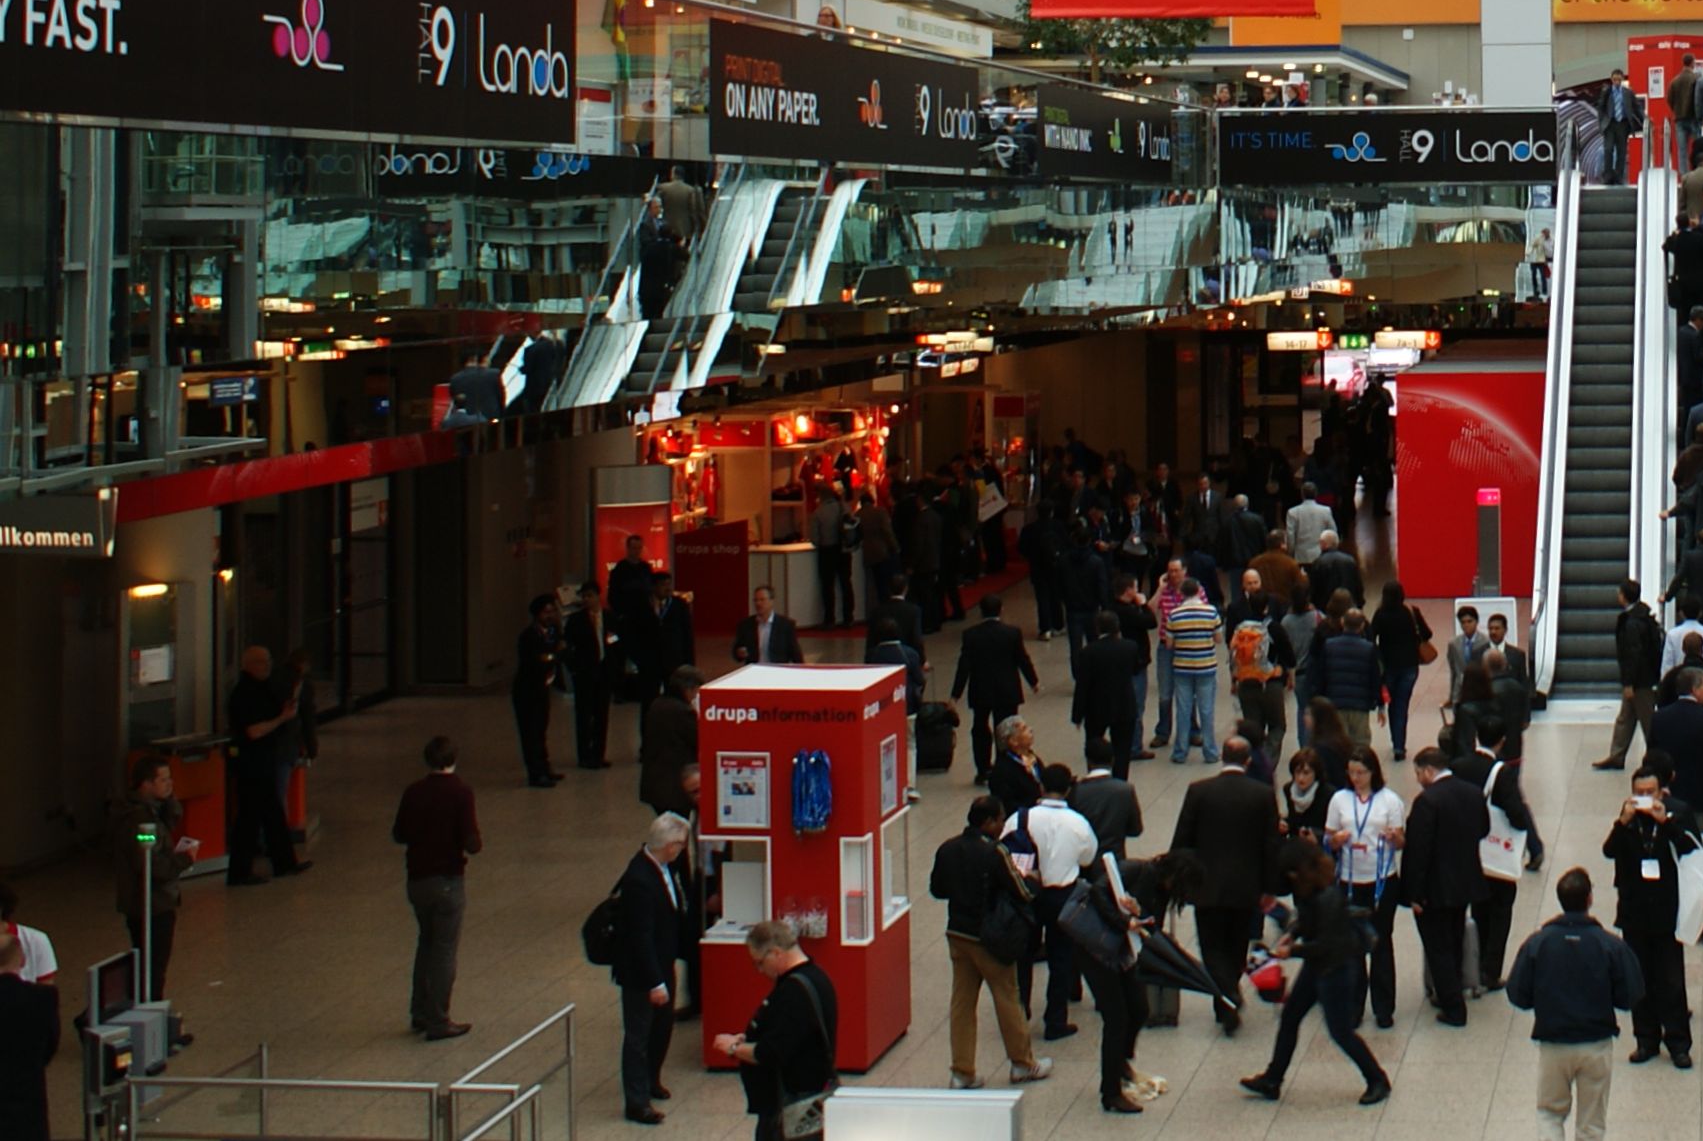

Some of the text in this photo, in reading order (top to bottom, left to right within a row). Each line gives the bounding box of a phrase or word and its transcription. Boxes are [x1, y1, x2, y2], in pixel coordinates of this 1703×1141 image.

[431, 6, 456, 86] 9
[479, 12, 569, 99] Landa
[725, 81, 820, 126] ON ANY PAPER.
[919, 84, 930, 136] 9
[1230, 131, 1317, 150] IT'S TIME.
[1411, 128, 1434, 163] 9
[1456, 128, 1554, 163] Landa
[705, 705, 758, 724] drupa
